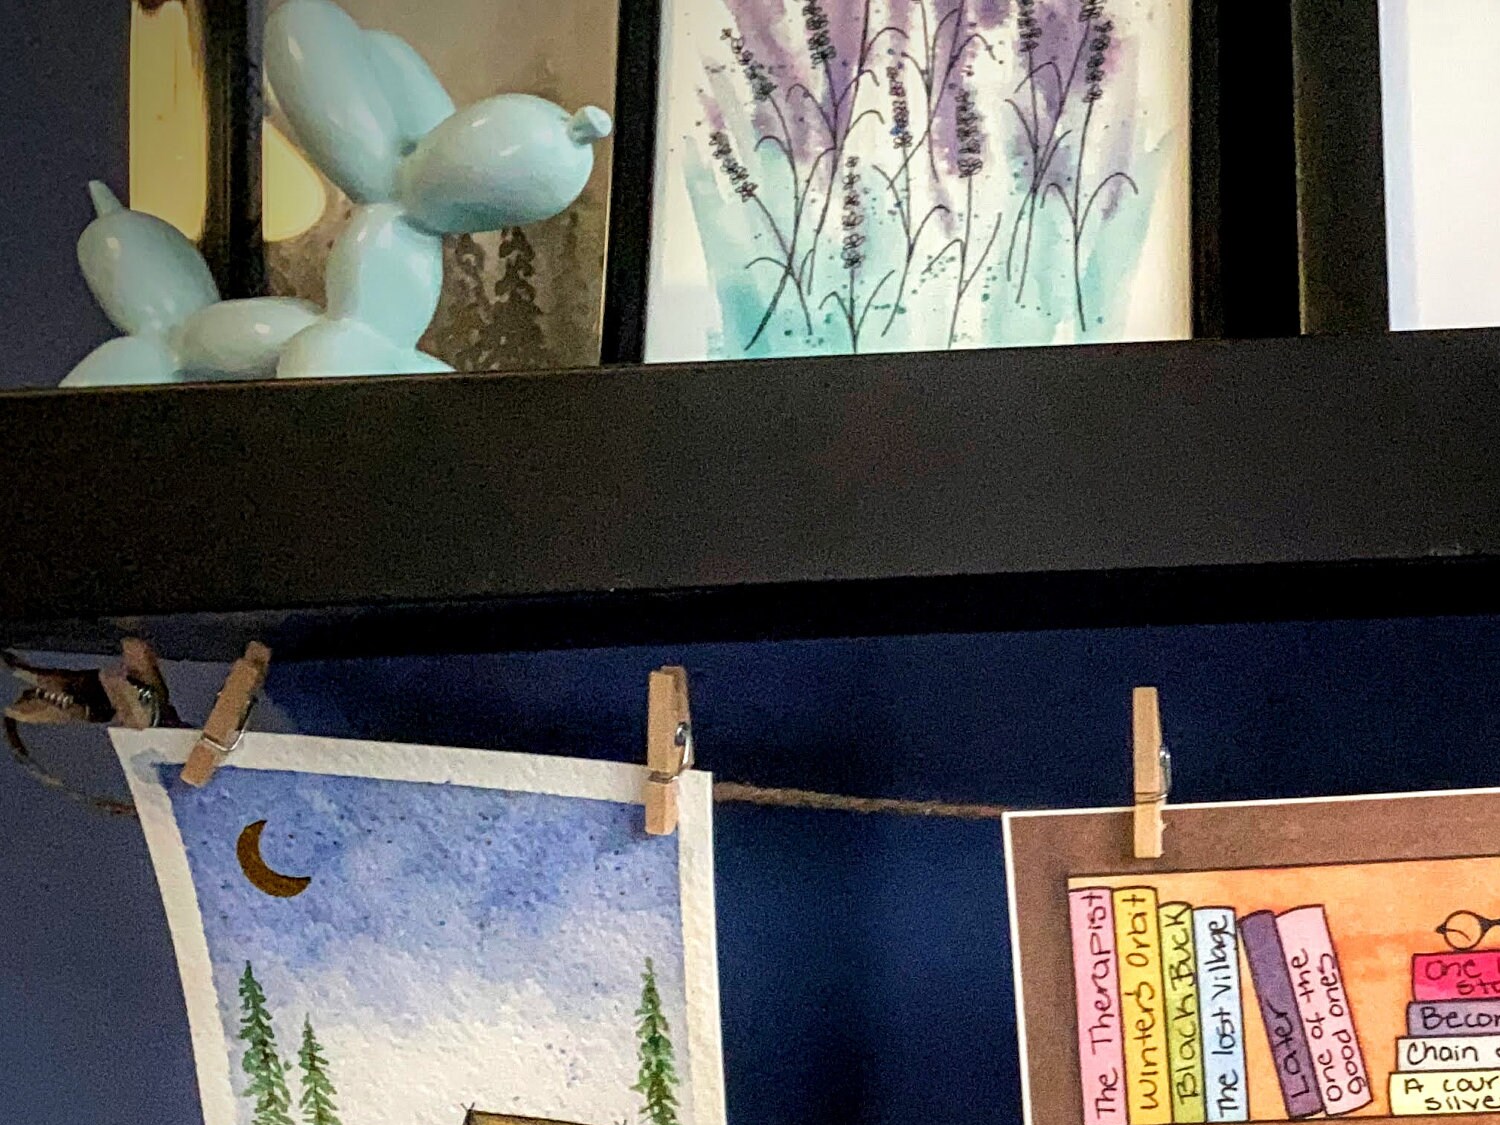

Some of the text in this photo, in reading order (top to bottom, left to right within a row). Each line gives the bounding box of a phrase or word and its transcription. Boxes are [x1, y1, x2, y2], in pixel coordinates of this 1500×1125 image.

[1123, 894, 1148, 967] Orbit
[1291, 948, 1315, 998] the
[1081, 891, 1118, 1119] The Therapist
[1164, 905, 1199, 1106] Black Buck
[1306, 1012, 1325, 1038] of
[1316, 953, 1367, 1094] good ones
[1268, 1002, 1310, 1098] Later
[1406, 1041, 1478, 1065] Chain
[1219, 1069, 1239, 1117] The
[1405, 1079, 1424, 1094] A
